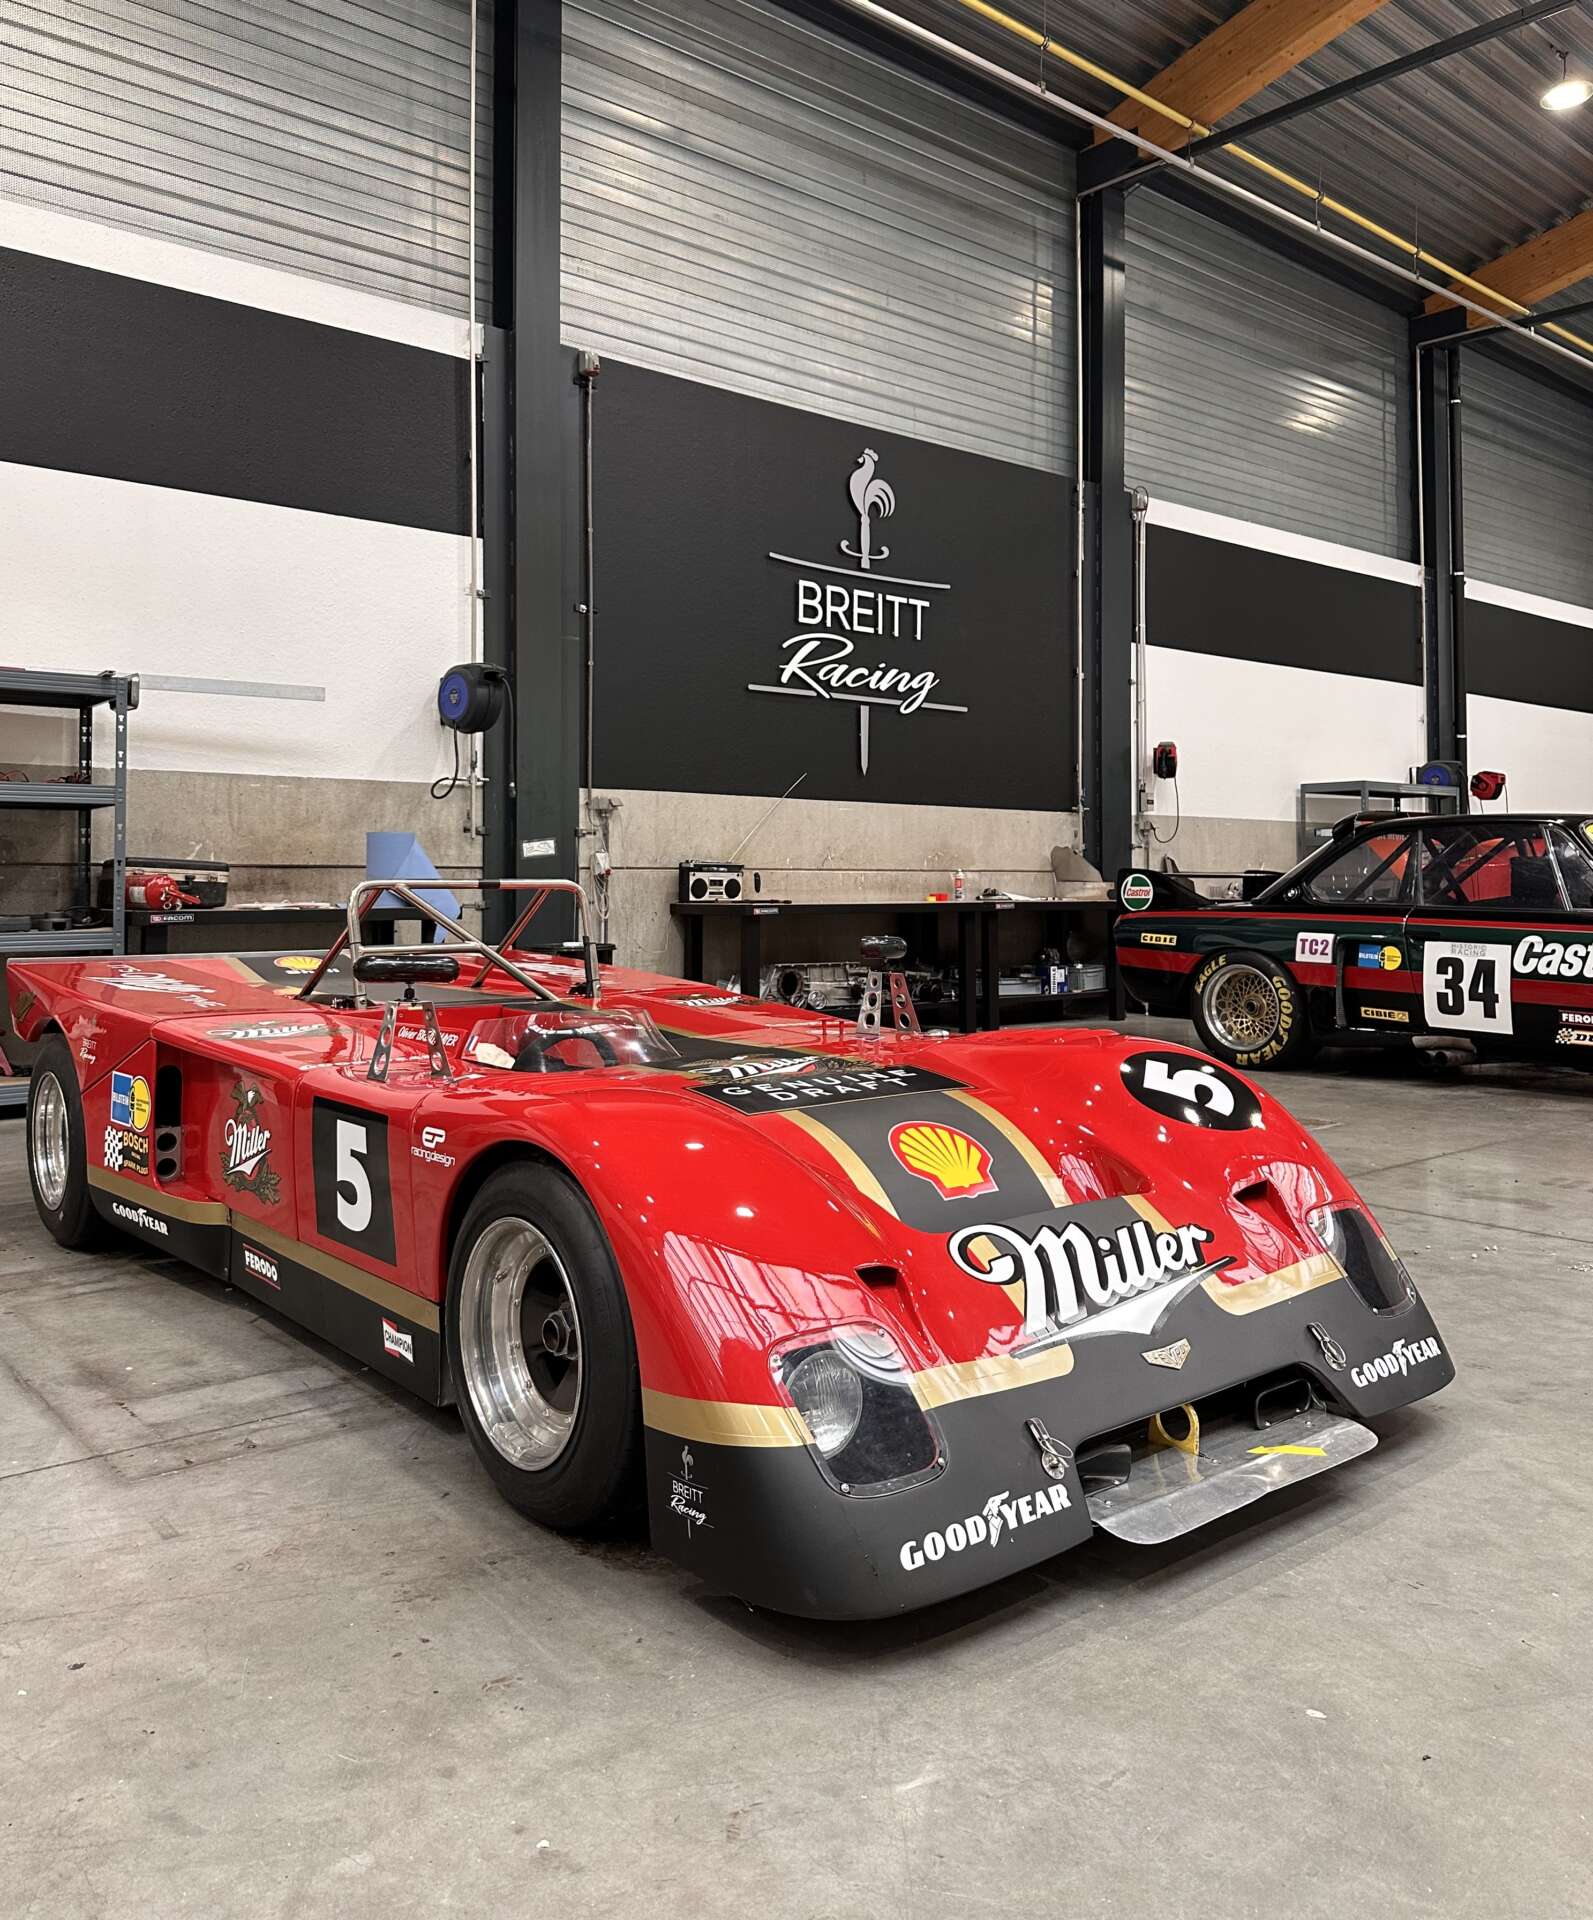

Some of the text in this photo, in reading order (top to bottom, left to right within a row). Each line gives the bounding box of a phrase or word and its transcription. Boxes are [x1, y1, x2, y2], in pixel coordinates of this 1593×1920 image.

[798, 579, 930, 641] BREITT
[779, 633, 940, 714] Racing
[1126, 887, 1152, 898] Castrol
[1299, 938, 1329, 956] TC2
[1194, 954, 1227, 994] EAGLE
[1436, 956, 1500, 1020] 34
[1236, 975, 1293, 1065] GOODYEAR
[688, 1055, 821, 1080] Miller
[722, 1069, 918, 1096] GENUINE
[767, 1078, 910, 1102] DRAFT
[1142, 1059, 1235, 1117] 5
[123, 1131, 149, 1153] BOSCH
[225, 1118, 271, 1168] Miller
[422, 1126, 446, 1149] EP
[336, 1118, 373, 1232] 5
[112, 1202, 169, 1236] GOODYEAR
[244, 1250, 278, 1282] FERODO
[946, 1220, 1214, 1338] Miller
[384, 1329, 412, 1355] CHAMPION
[1351, 1336, 1442, 1388] GOODYEAR
[672, 1480, 703, 1503] BREITT
[670, 1494, 707, 1525] Racing
[900, 1483, 1072, 1571] GOODYEAR
